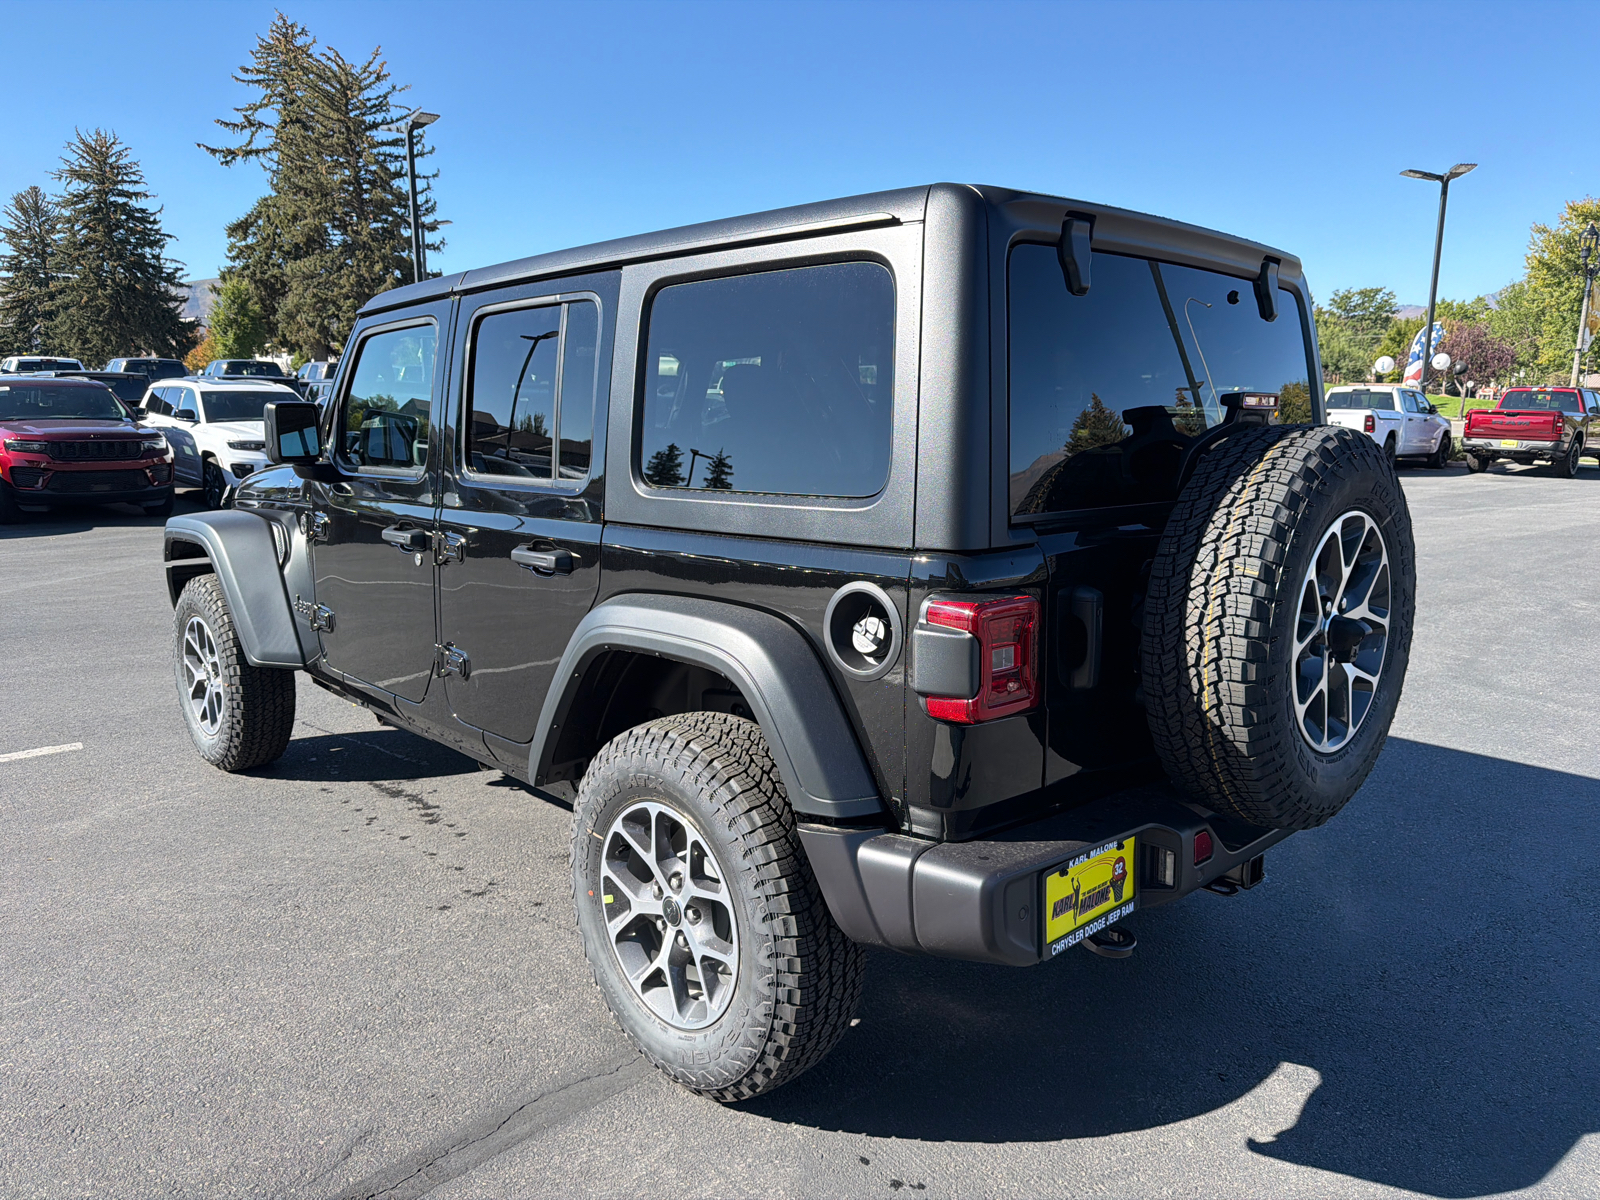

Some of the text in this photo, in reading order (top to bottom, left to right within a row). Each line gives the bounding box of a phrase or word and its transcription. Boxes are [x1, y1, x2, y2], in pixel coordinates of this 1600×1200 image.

[627, 773, 665, 793] ATX
[1068, 840, 1118, 869] KARL MALONE
[1114, 861, 1124, 876] 32
[1051, 893, 1075, 921] KARL
[1078, 885, 1111, 917] MALONE
[1051, 901, 1134, 956] CHRYSLER DODGE JEEP RAM
